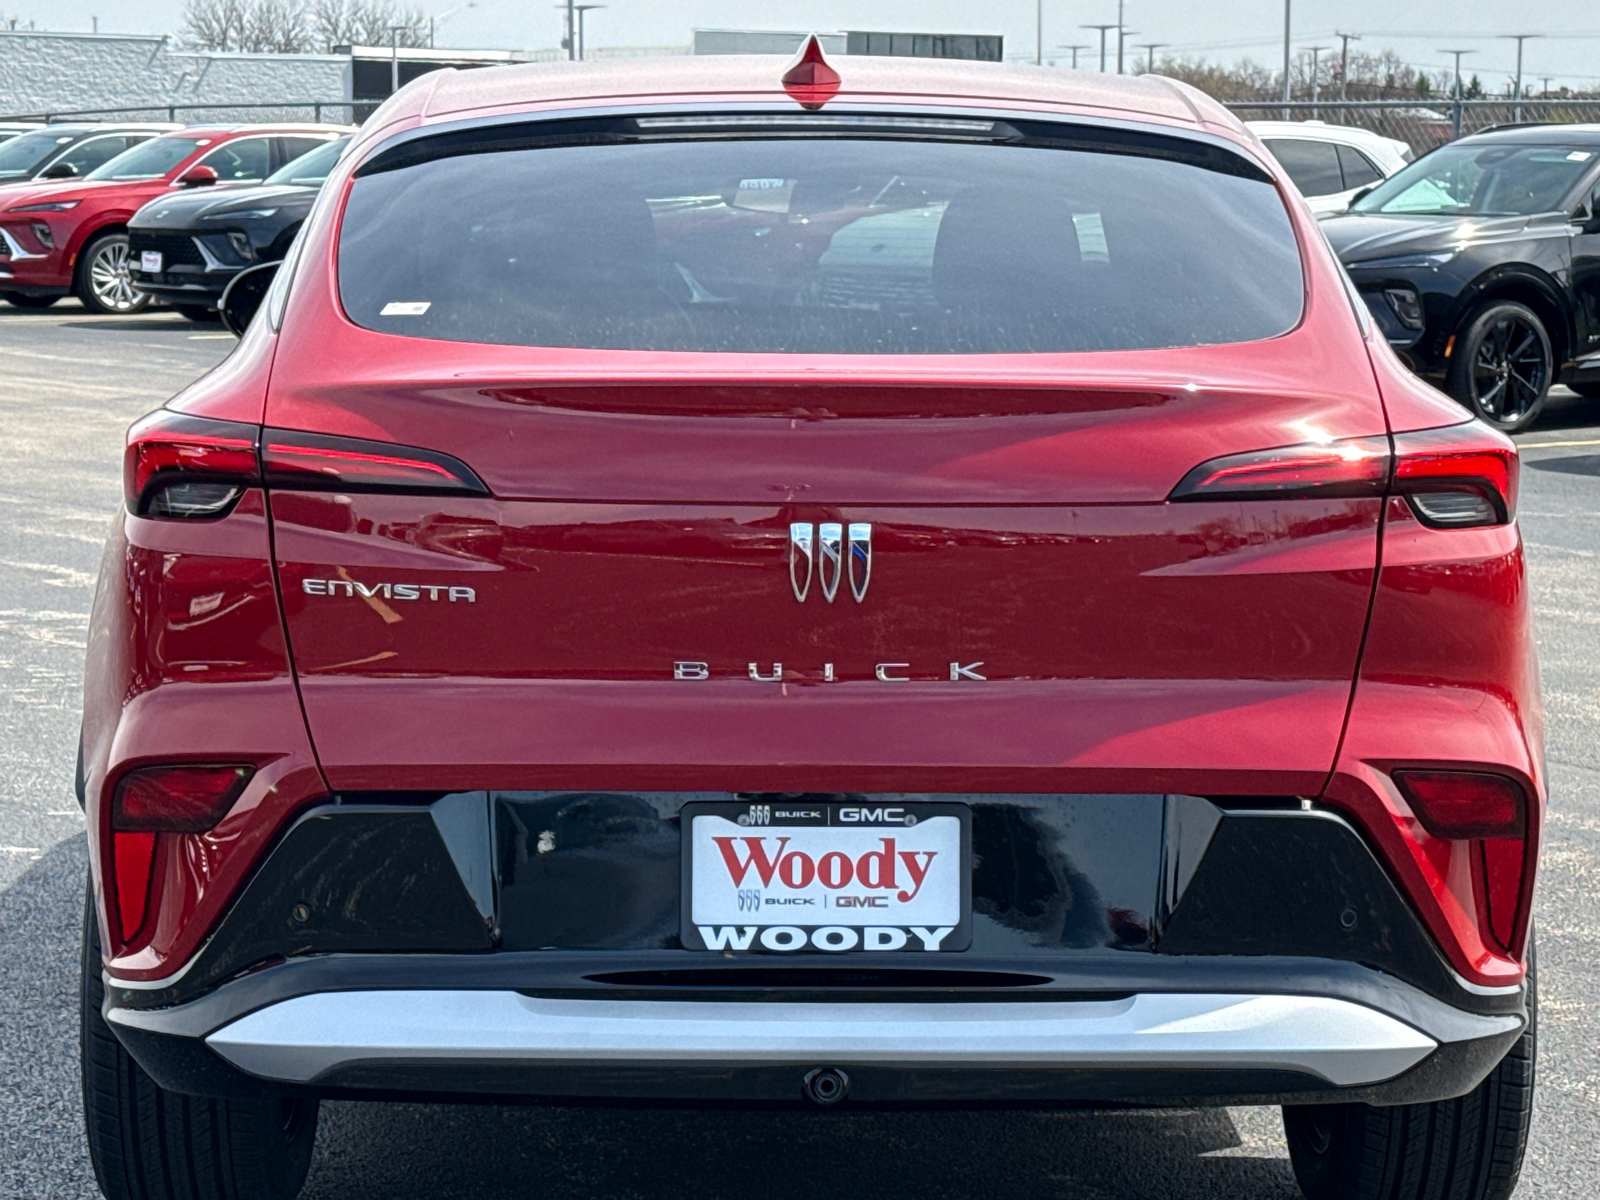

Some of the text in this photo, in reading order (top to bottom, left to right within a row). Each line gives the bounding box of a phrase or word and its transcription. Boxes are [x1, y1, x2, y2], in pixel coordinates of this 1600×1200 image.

[302, 578, 477, 603] ENVISTA
[673, 661, 987, 682] BUICK
[774, 807, 905, 823] BUICK GMC
[711, 836, 938, 903] Woody
[765, 895, 889, 908] BUICK GMC
[697, 925, 956, 951] WOODY
